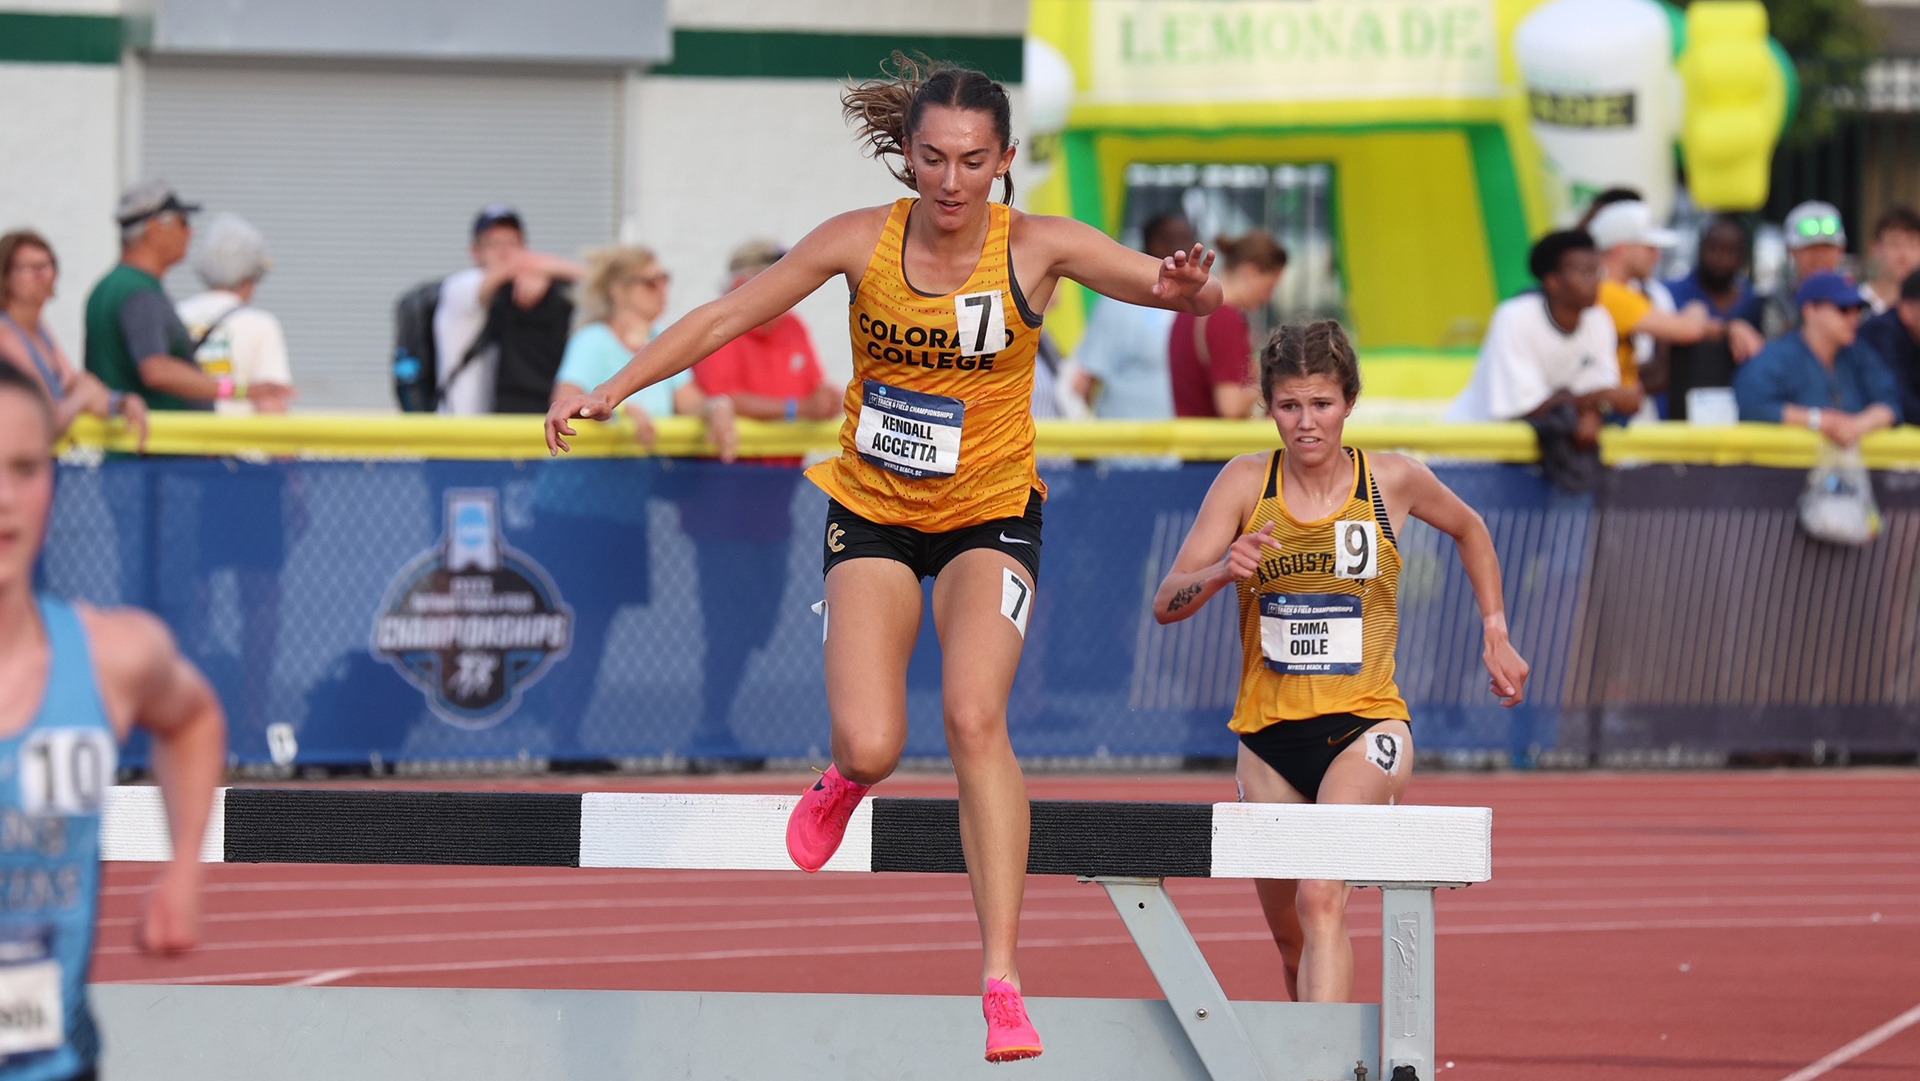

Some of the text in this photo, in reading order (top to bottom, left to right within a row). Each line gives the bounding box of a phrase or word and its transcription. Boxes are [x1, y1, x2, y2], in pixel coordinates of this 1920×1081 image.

[1119, 8, 1484, 66] LEMONADE
[859, 312, 1015, 349] COLOR
[964, 295, 992, 352] 7
[867, 341, 998, 371] COLLEGE
[882, 415, 933, 440] KENDALL
[896, 402, 909, 412] FIELD
[909, 406, 954, 419] CHAMPIONSHIPS
[872, 432, 937, 463] ACCETTA
[1344, 523, 1369, 575] 9
[1256, 552, 1366, 587] AUGUST
[1011, 574, 1027, 621] 7
[1290, 621, 1329, 635] EMMA
[1290, 639, 1329, 656] ODLE
[1375, 733, 1396, 771] 9
[33, 739, 98, 810] 10
